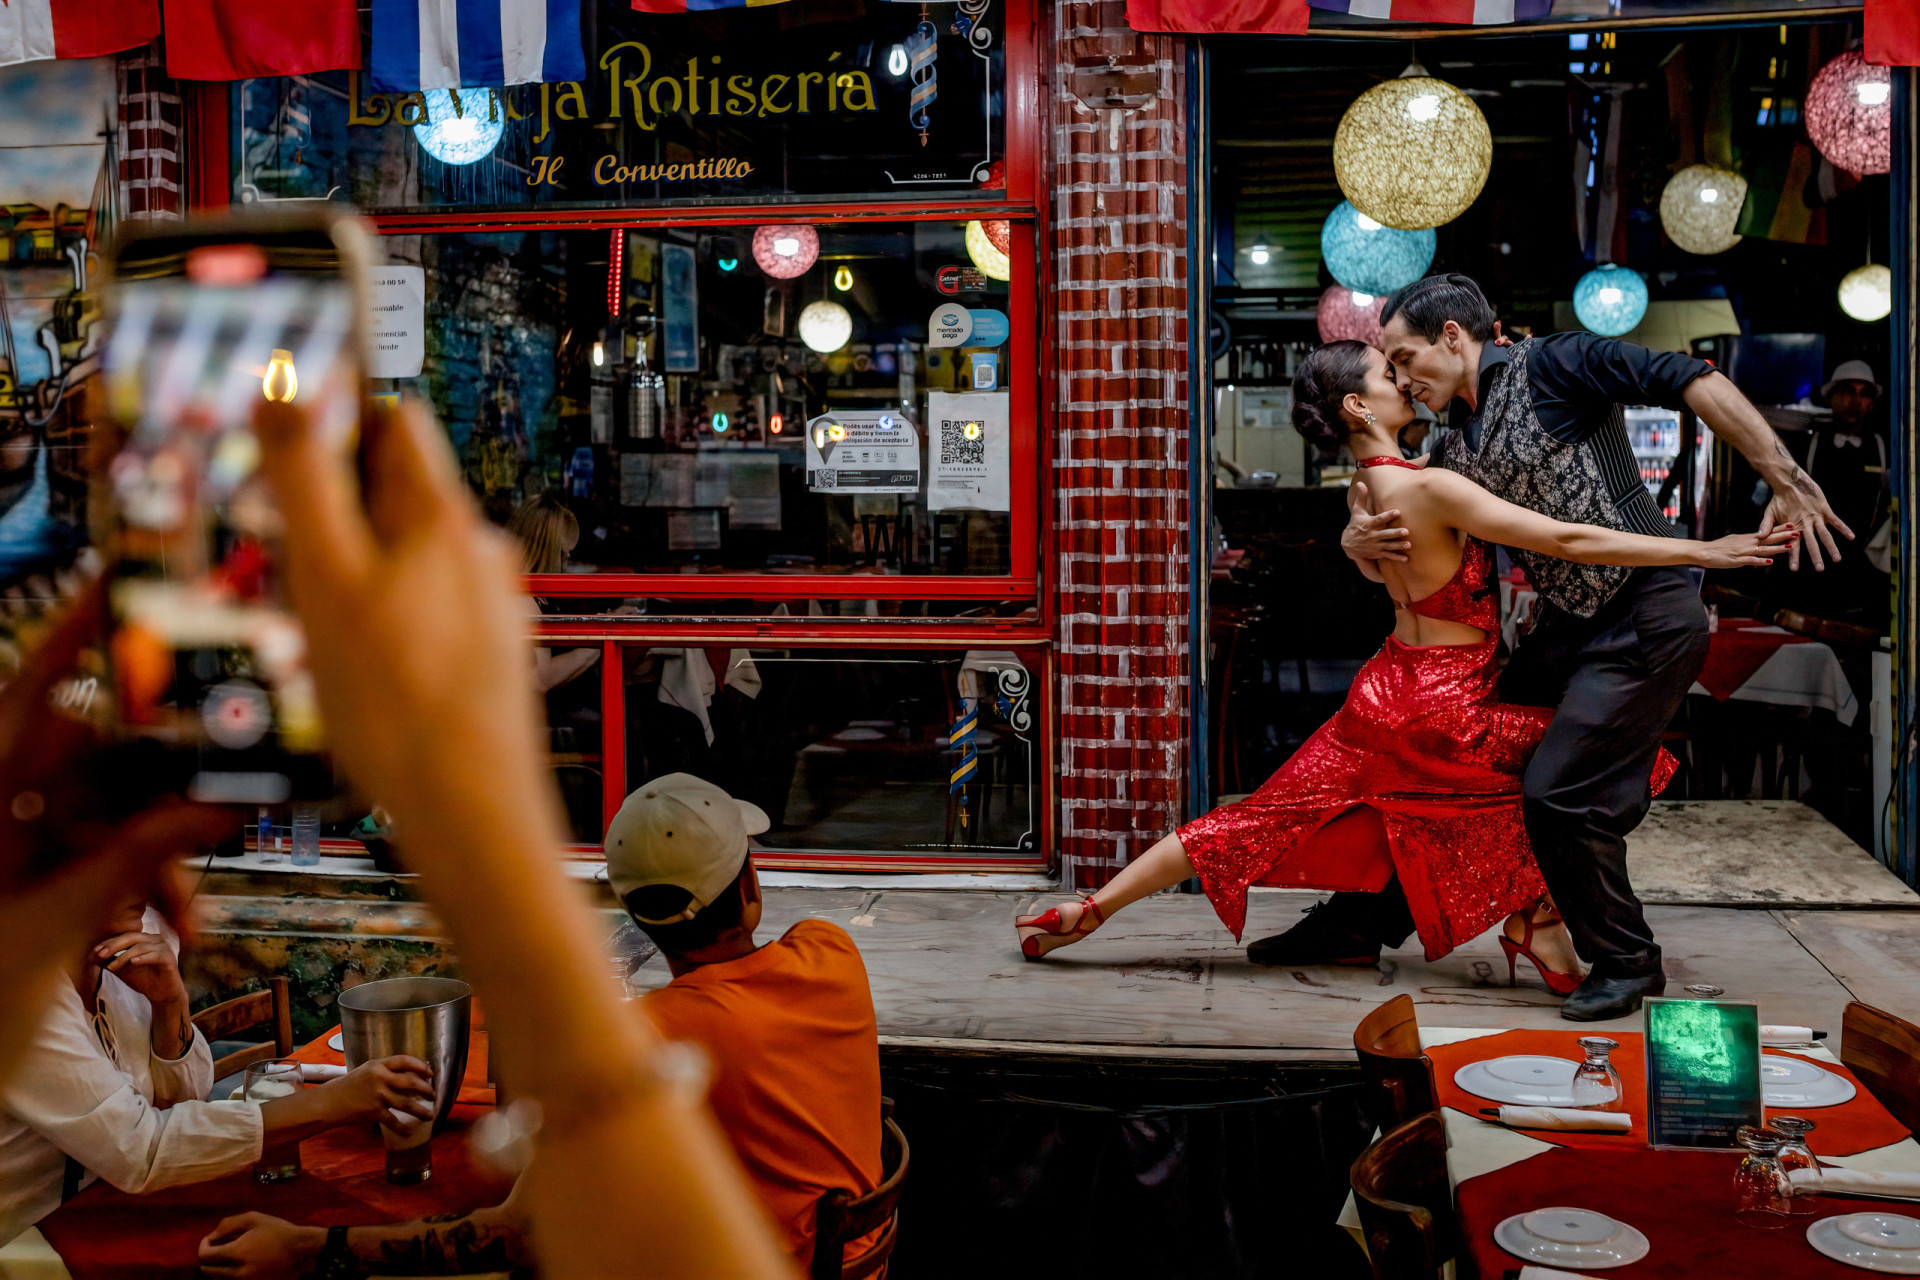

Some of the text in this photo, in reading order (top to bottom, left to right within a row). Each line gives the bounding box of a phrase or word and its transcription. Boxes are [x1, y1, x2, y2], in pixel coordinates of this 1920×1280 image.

[347, 69, 429, 126] La
[600, 41, 877, 131] Rotisería
[593, 153, 755, 186] Conventillo
